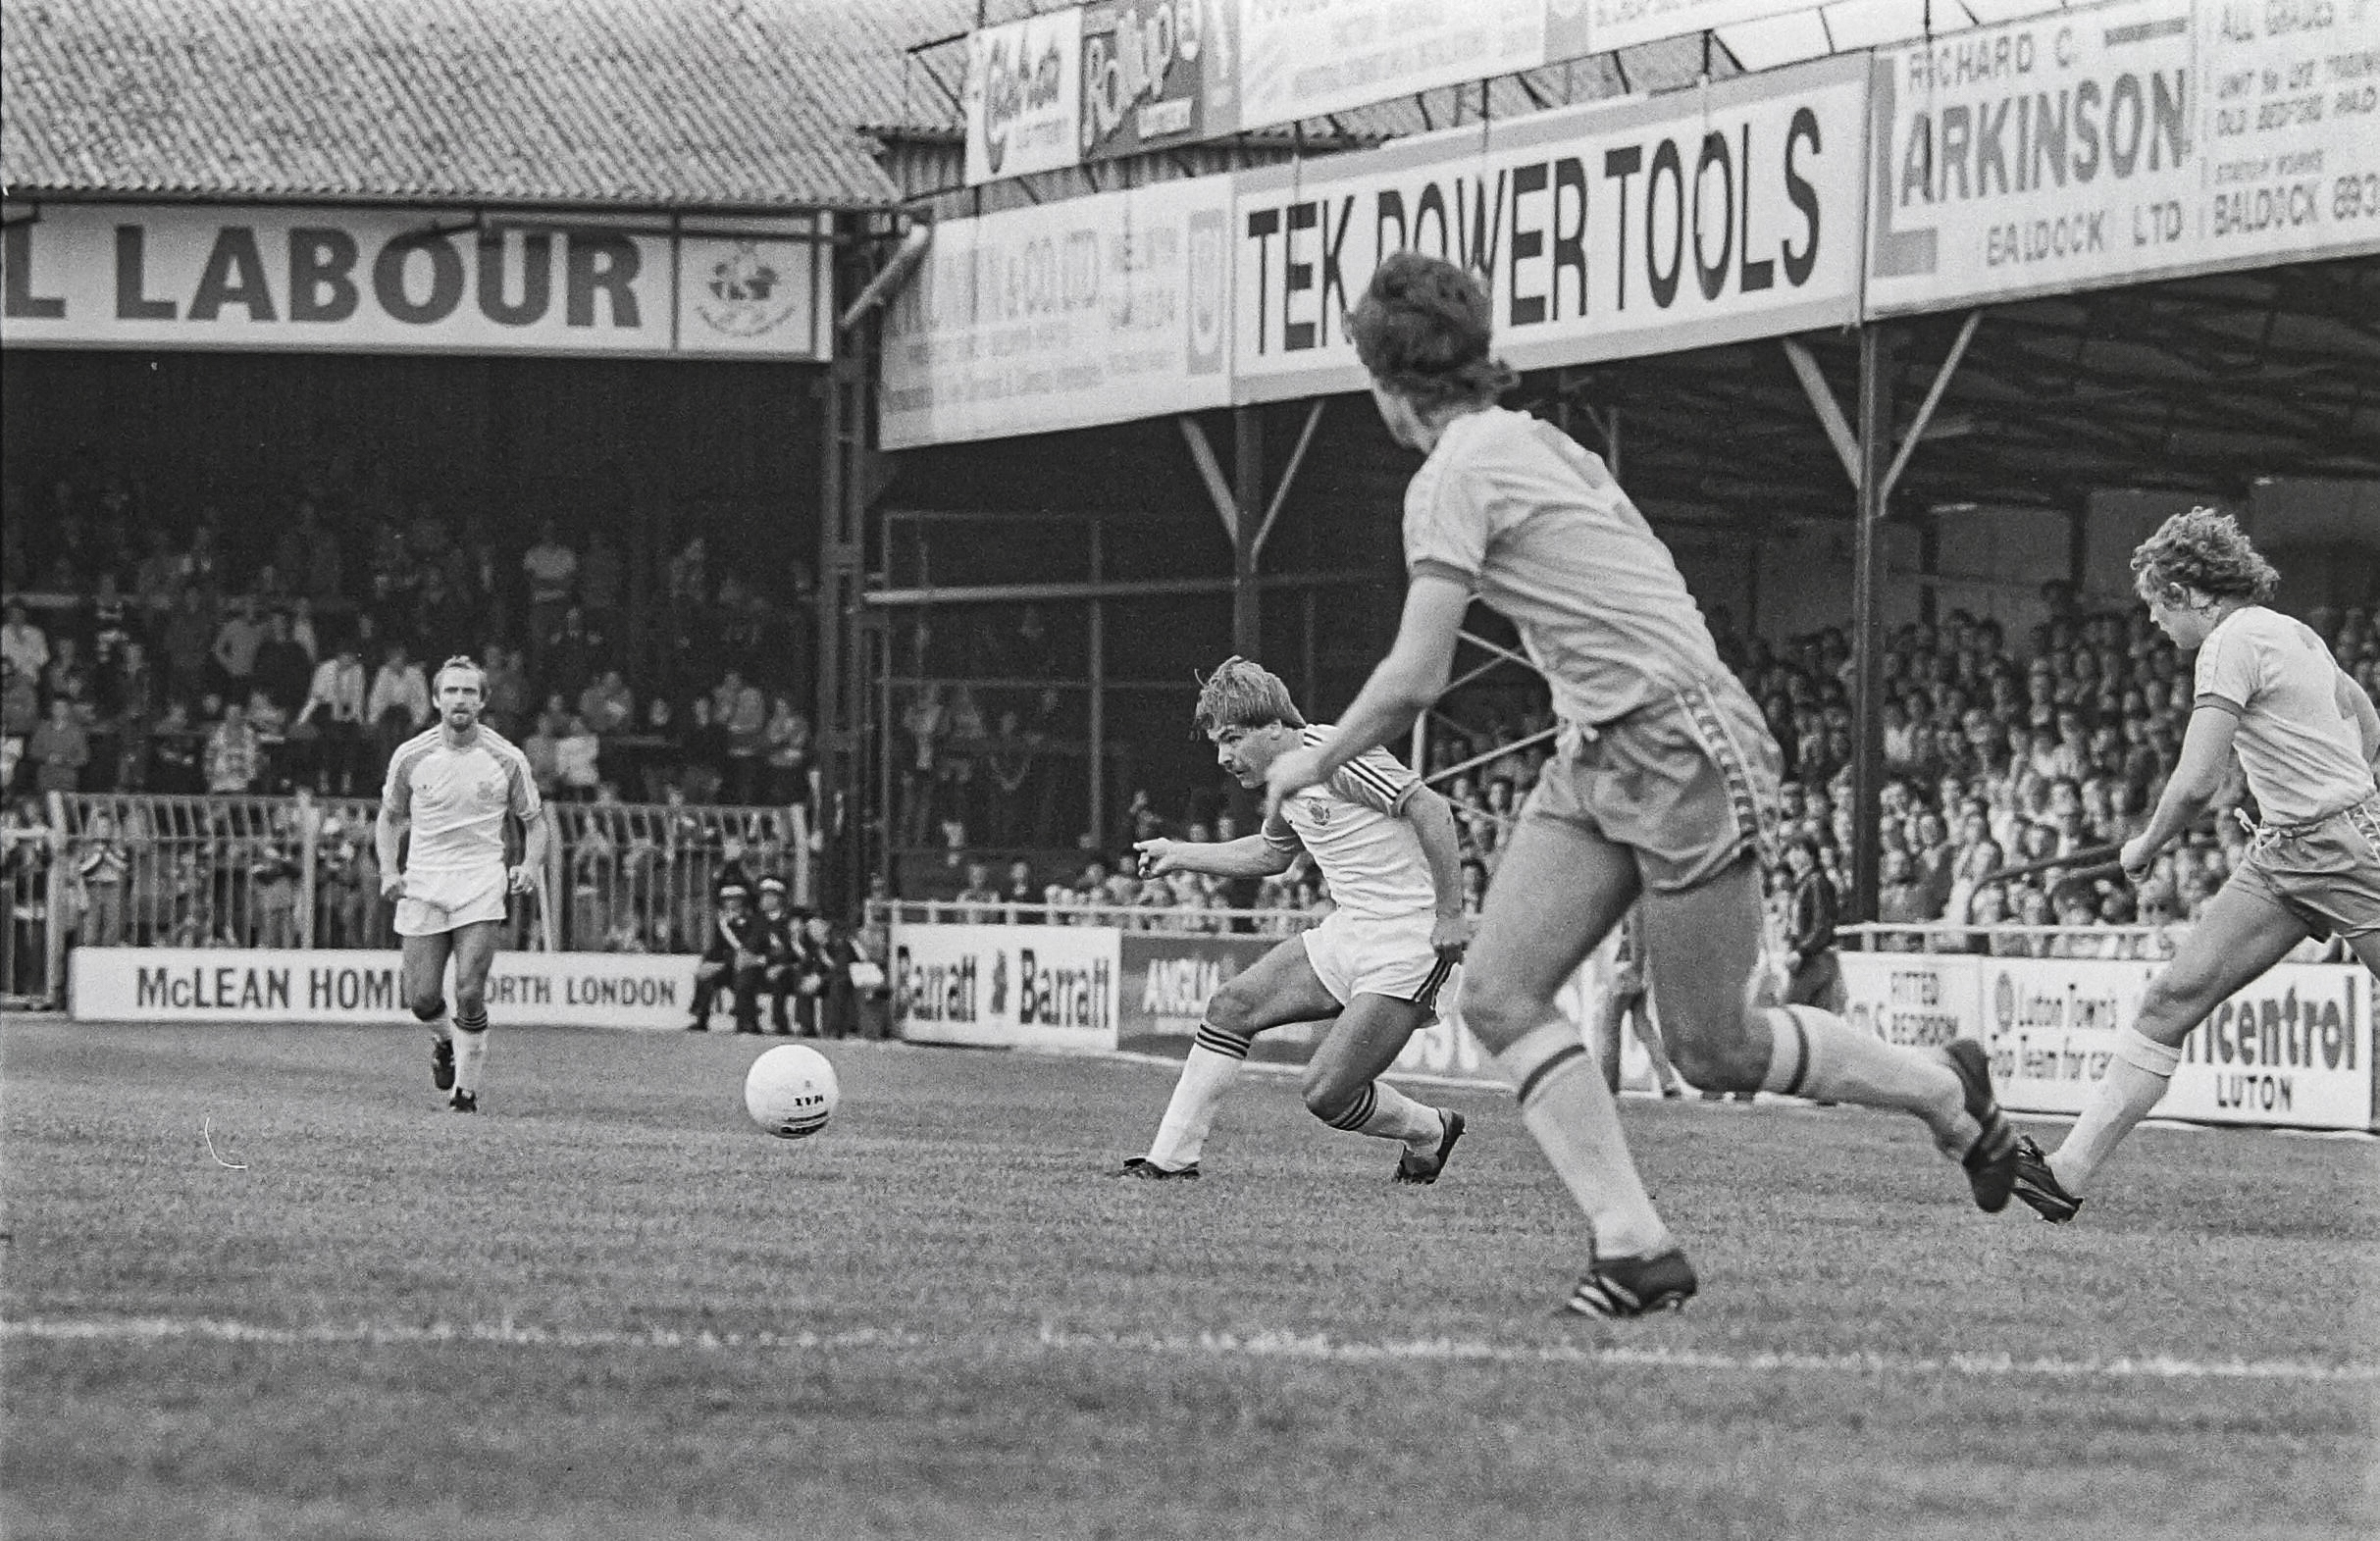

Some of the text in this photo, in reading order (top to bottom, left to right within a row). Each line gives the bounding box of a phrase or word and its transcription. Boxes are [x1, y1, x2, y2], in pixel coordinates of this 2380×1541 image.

[1908, 33, 2035, 93] RICHARD
[1248, 193, 1355, 356] TEK
[1604, 105, 1823, 311] TOOLS
[1988, 200, 2183, 267] BALDOCK LTD
[115, 224, 644, 329] LABOUR
[136, 966, 289, 1009] McLEAN
[566, 976, 676, 1006] LONDON
[894, 945, 1110, 1029] Barratt Barratt
[2216, 1074, 2292, 1112] LUTON
